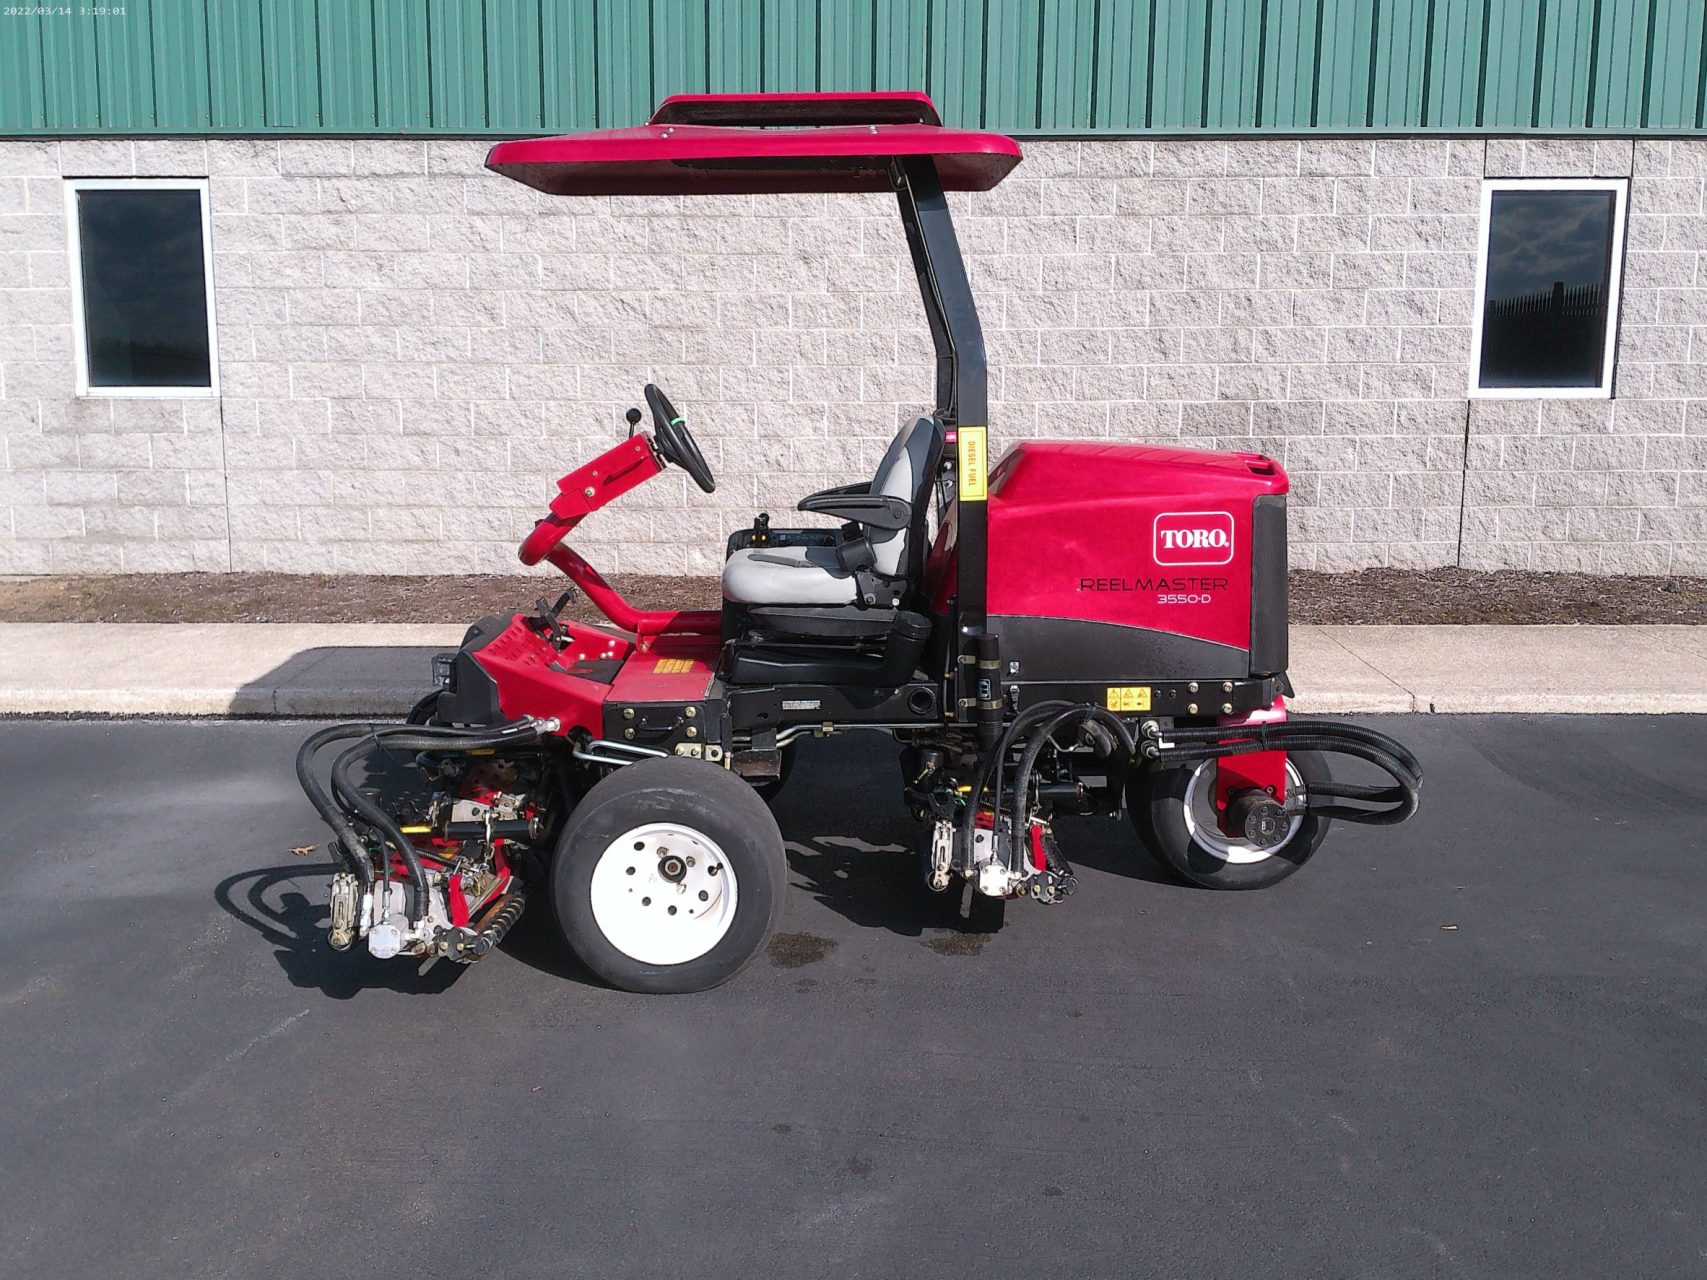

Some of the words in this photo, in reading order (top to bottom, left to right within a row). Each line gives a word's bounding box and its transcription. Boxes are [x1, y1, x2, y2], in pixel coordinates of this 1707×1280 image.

[967, 440, 976, 466] DIESEL
[968, 468, 977, 487] FUEL
[1080, 577, 1229, 592] REELMASTER
[1157, 594, 1212, 604] 3550-D
